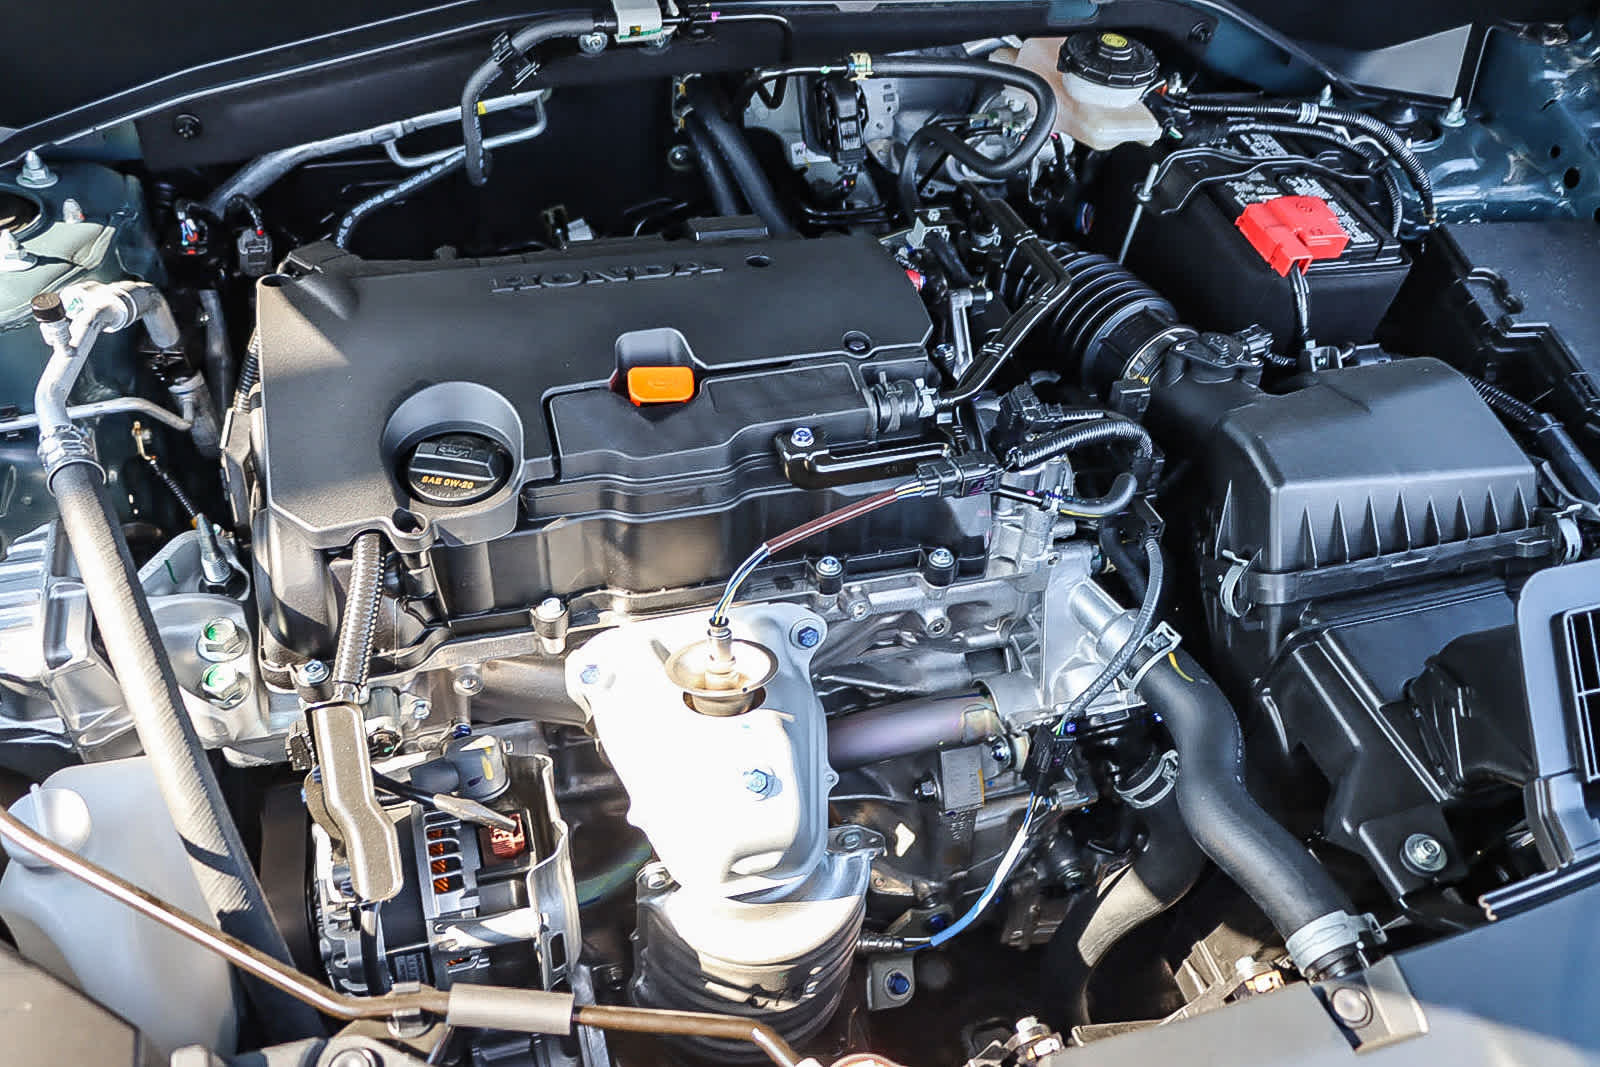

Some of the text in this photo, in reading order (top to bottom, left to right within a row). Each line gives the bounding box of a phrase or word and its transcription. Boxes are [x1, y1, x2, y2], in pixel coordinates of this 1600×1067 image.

[491, 263, 724, 292] HONDA
[421, 475, 475, 489] SAE 0W-20
